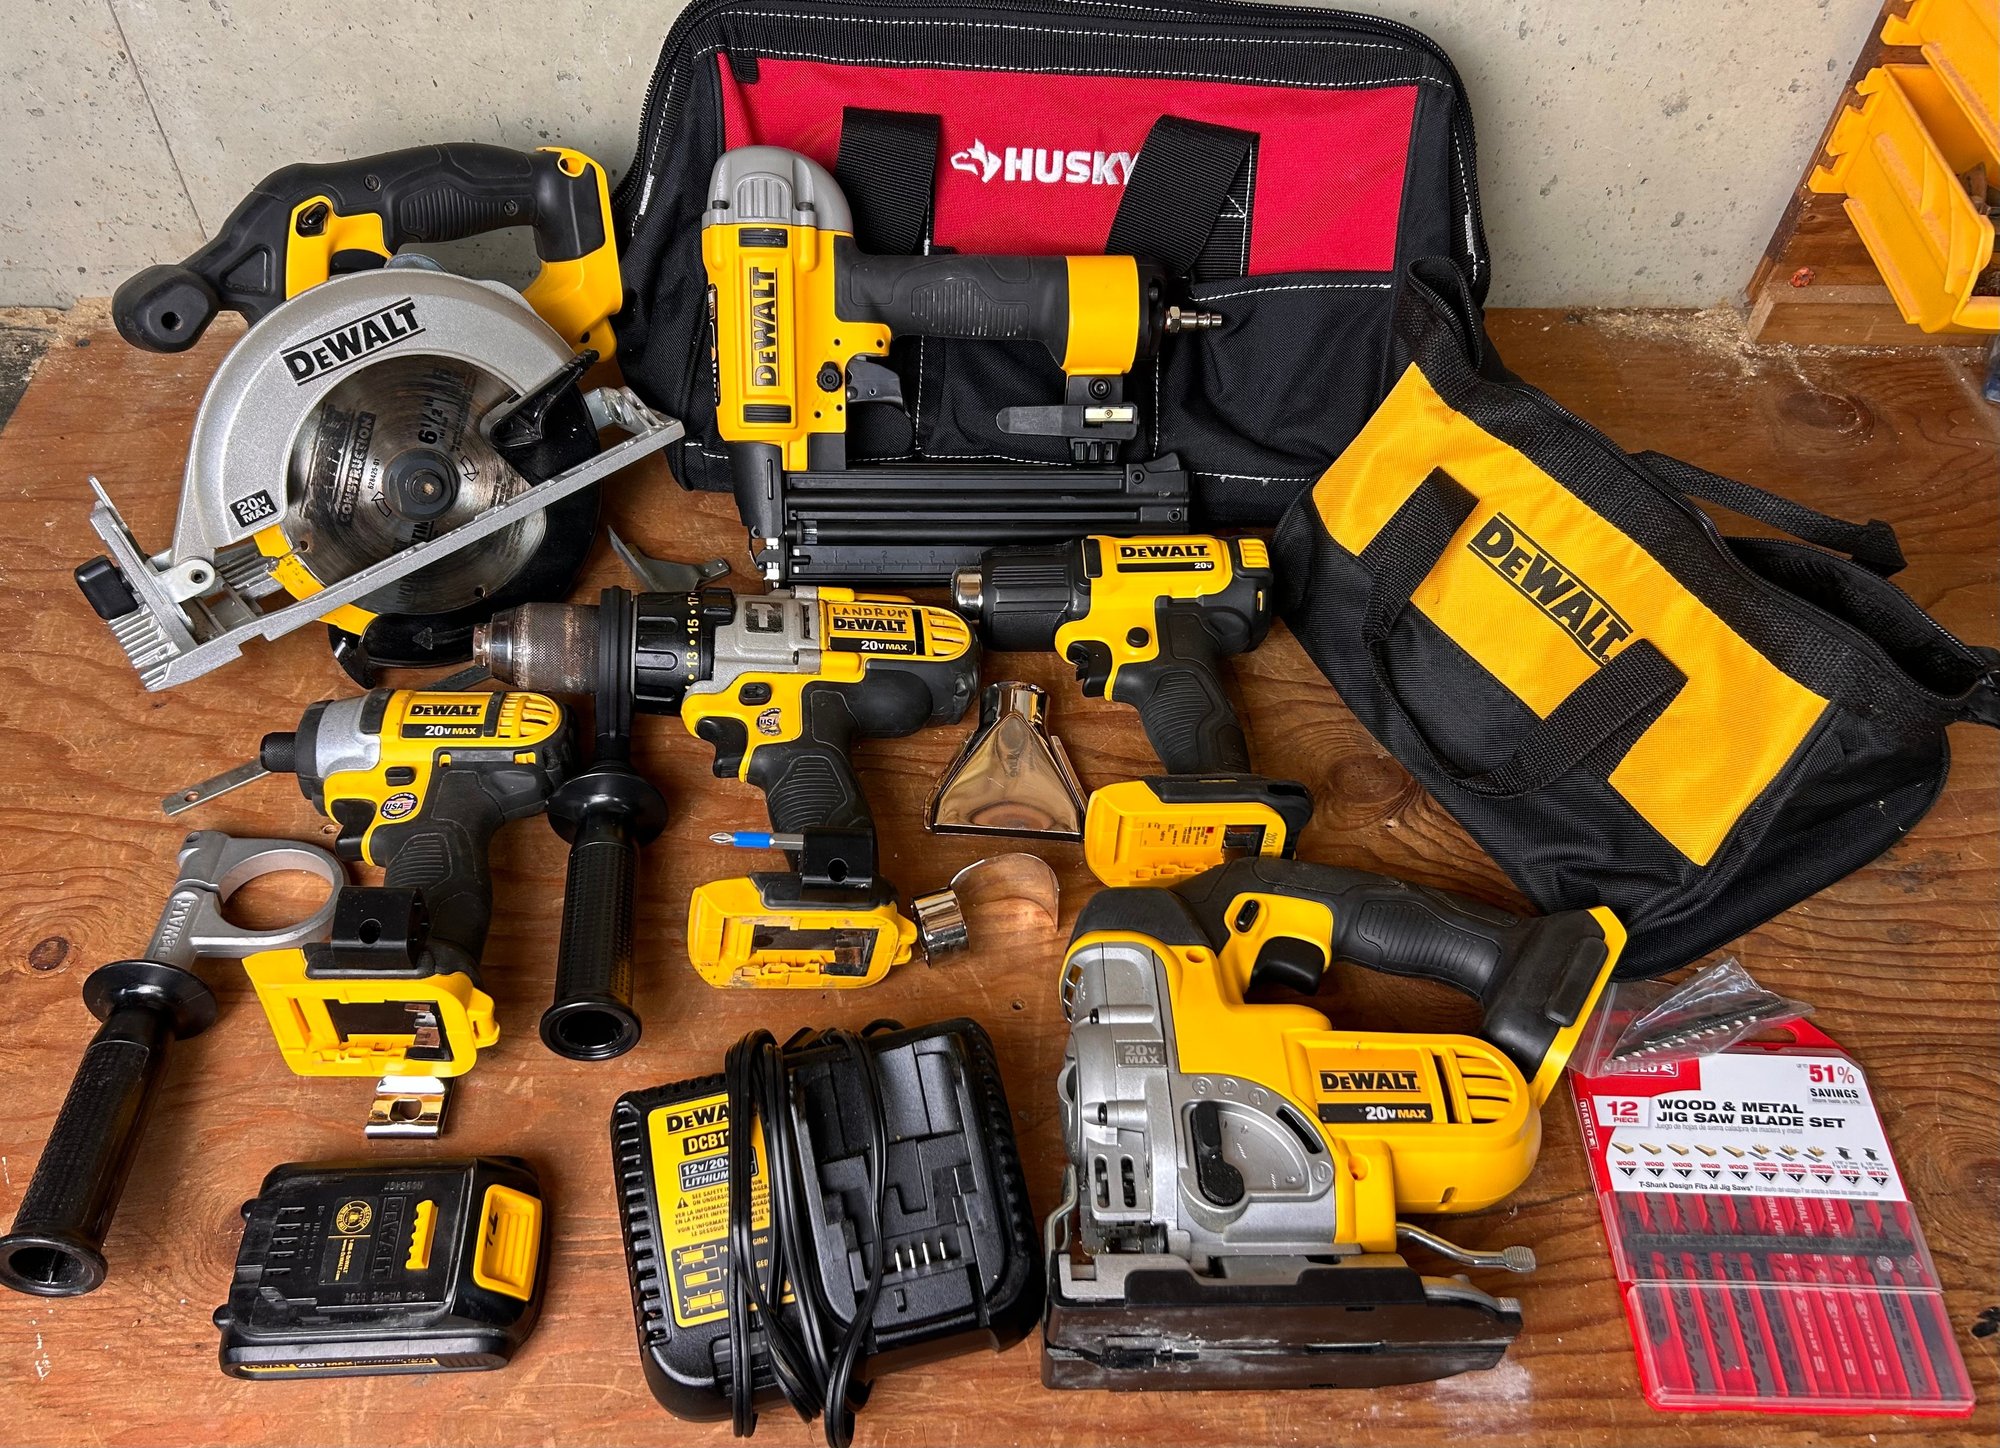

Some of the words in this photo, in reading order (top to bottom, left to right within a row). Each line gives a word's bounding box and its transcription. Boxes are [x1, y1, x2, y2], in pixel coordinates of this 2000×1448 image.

[1004, 147, 1139, 186] HUSKY
[242, 503, 274, 524] MAX
[832, 605, 909, 619] LANDRUM
[687, 619, 699, 634] 15
[686, 652, 698, 668] 13
[385, 802, 403, 811] USA
[1125, 1055, 1159, 1064] MAX
[1809, 1064, 1855, 1084] 51%
[1810, 1088, 1859, 1099] SAVINGS
[1397, 1109, 1426, 1119] MAX
[1607, 1100, 1638, 1116] 12
[1656, 1099, 1716, 1111] WOOD
[1721, 1101, 1736, 1112] &
[1742, 1102, 1804, 1114] METAL
[666, 1102, 728, 1134] DEWA
[1579, 1101, 1593, 1138] DIABLO
[1656, 1111, 1688, 1123] JIG
[1694, 1112, 1734, 1124] SAW
[1741, 1114, 1804, 1127] BLADE
[1809, 1117, 1846, 1129] SET
[1655, 1123, 1673, 1131] Juego
[703, 1188, 724, 1197] SAFETY
[1638, 1181, 1667, 1189] T-Shank
[1669, 1182, 1693, 1190] Design
[692, 1213, 710, 1223] PARTE
